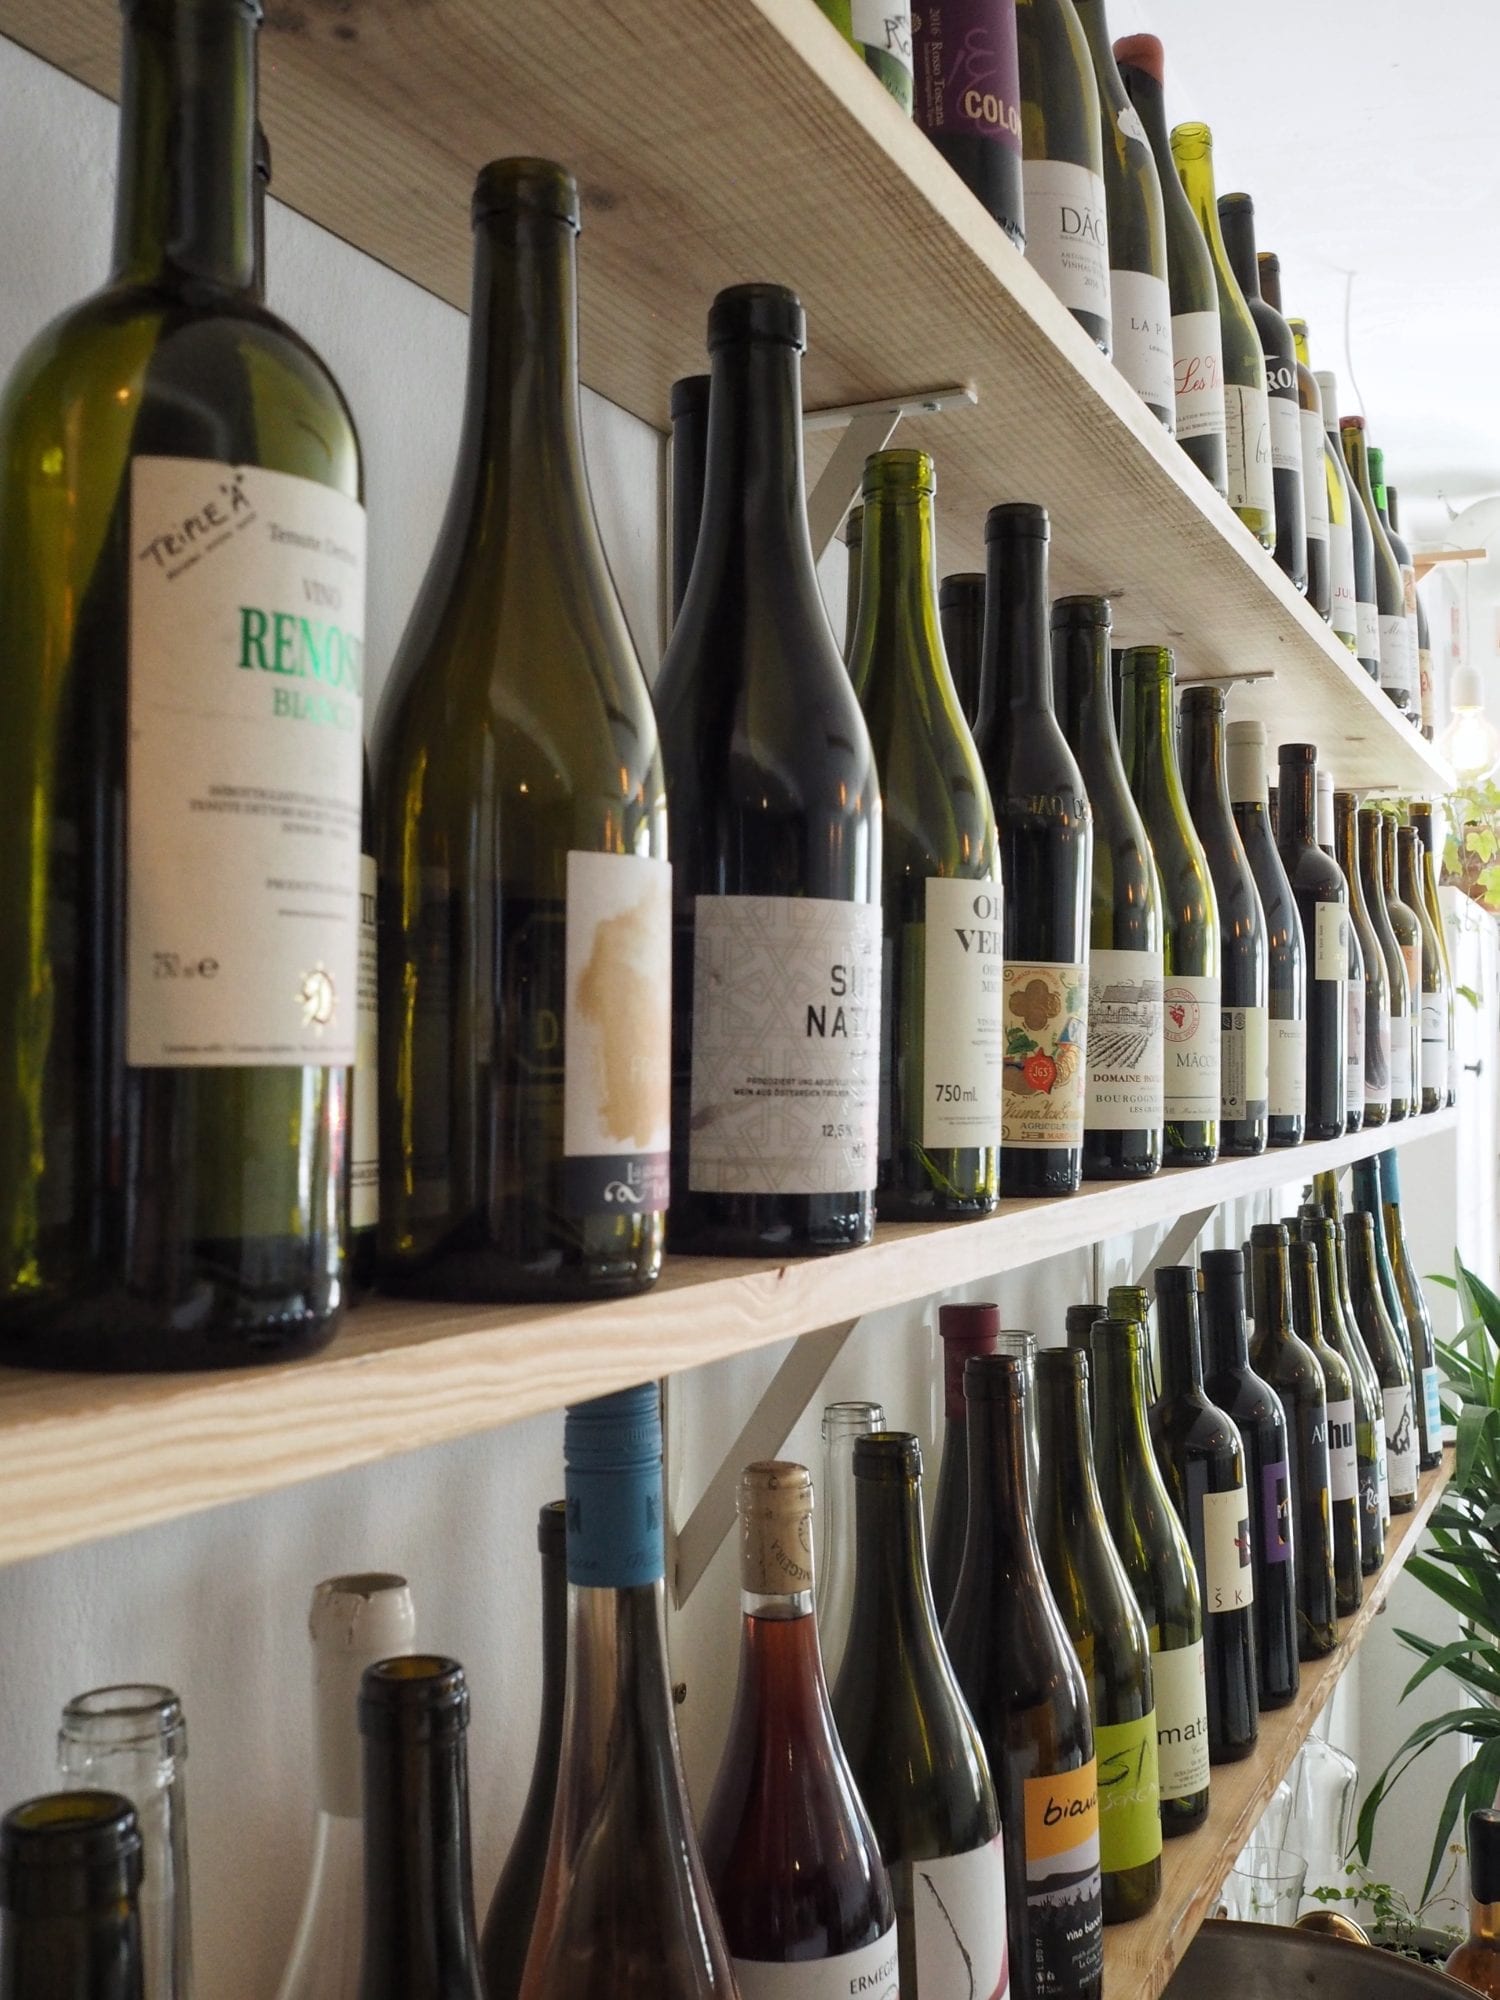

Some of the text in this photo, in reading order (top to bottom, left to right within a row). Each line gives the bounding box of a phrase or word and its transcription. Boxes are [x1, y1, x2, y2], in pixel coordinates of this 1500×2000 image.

[931, 41, 944, 77] Rosso
[933, 77, 946, 126] Toscana
[1131, 318, 1149, 332] LA
[1093, 1074, 1141, 1083] DOMAINE
[935, 1084, 962, 1102] 750
